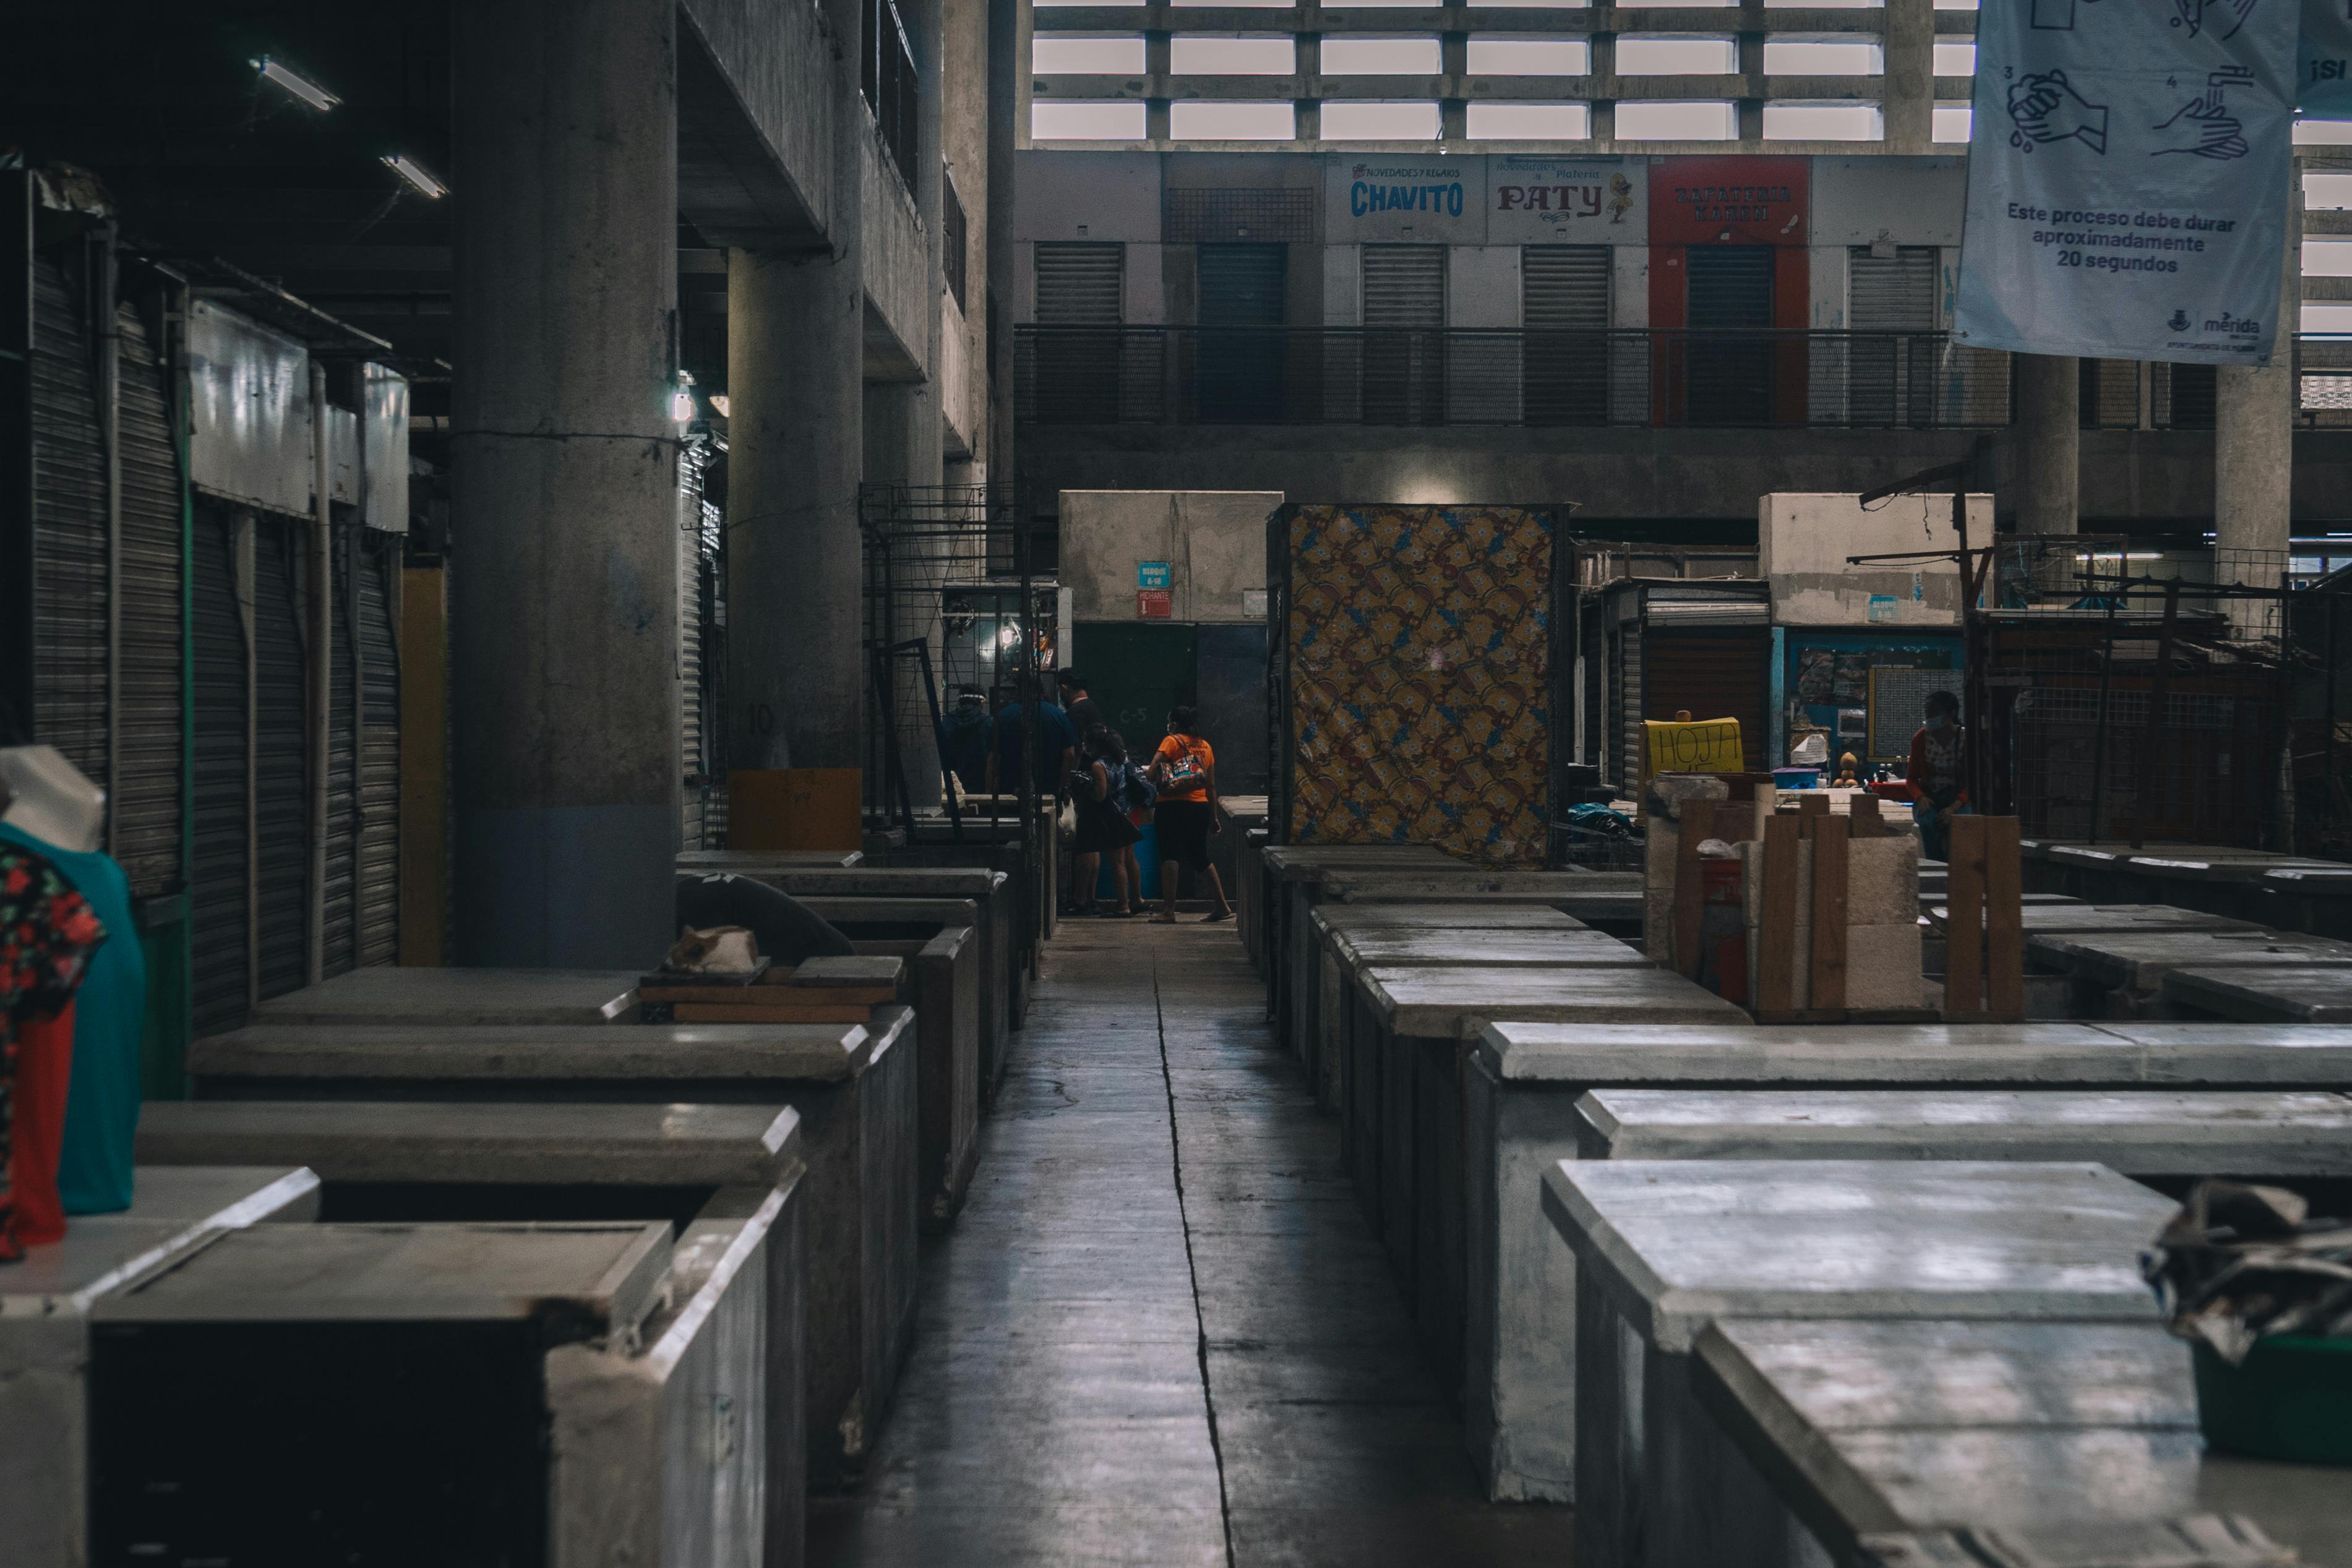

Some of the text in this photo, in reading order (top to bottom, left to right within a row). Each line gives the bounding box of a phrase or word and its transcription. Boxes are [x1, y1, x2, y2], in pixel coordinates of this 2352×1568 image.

[2004, 66, 2013, 79] 3
[2166, 75, 2178, 89] 4
[1367, 168, 1418, 178] NOVEDADES
[1419, 168, 1424, 178] Y
[1351, 181, 1463, 217] CHAVITO
[1497, 186, 1602, 217] PATY
[1675, 187, 1792, 203] ZAPATERIA
[1695, 205, 1769, 221] KAREN
[2007, 202, 2236, 233] Este proceso debe durar
[2033, 229, 2205, 252] aproximadamente
[2057, 250, 2178, 273] 20 segundos
[1140, 591, 1169, 600] HIDRANTE
[1659, 722, 1738, 765] HOJA
